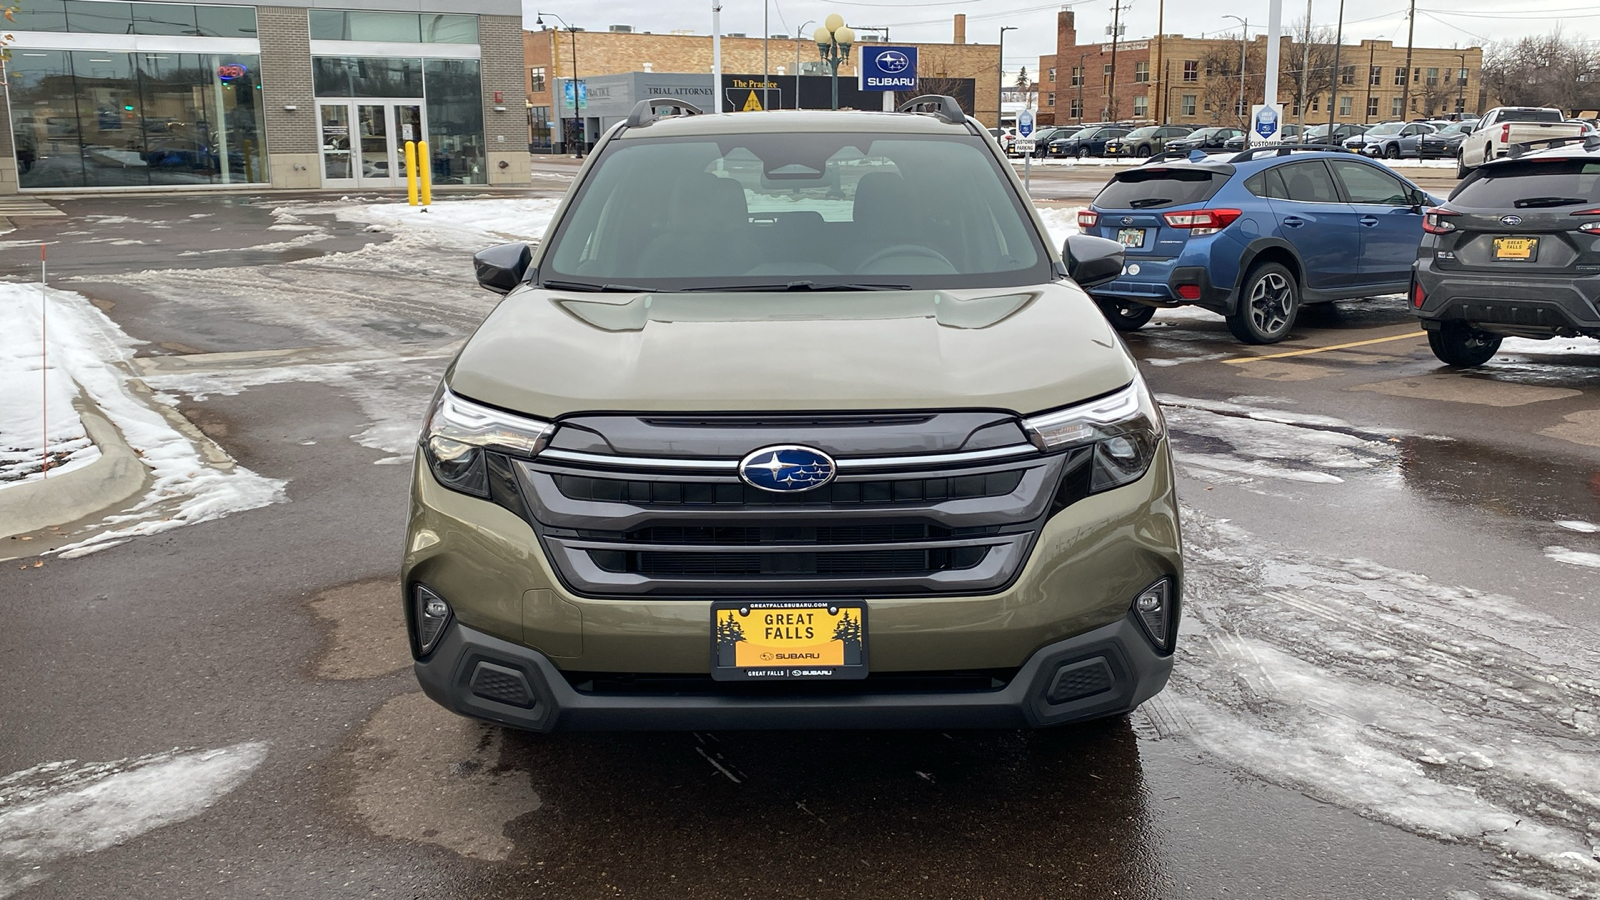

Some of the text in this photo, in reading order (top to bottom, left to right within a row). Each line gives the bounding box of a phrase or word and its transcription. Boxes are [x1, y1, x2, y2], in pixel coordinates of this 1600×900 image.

[218, 66, 244, 77] OPEN
[733, 80, 777, 88] The Pracice
[867, 77, 915, 87] SUBARU
[649, 87, 673, 95] TRIAL
[765, 614, 814, 625] GREAT
[765, 627, 814, 639] FALLS
